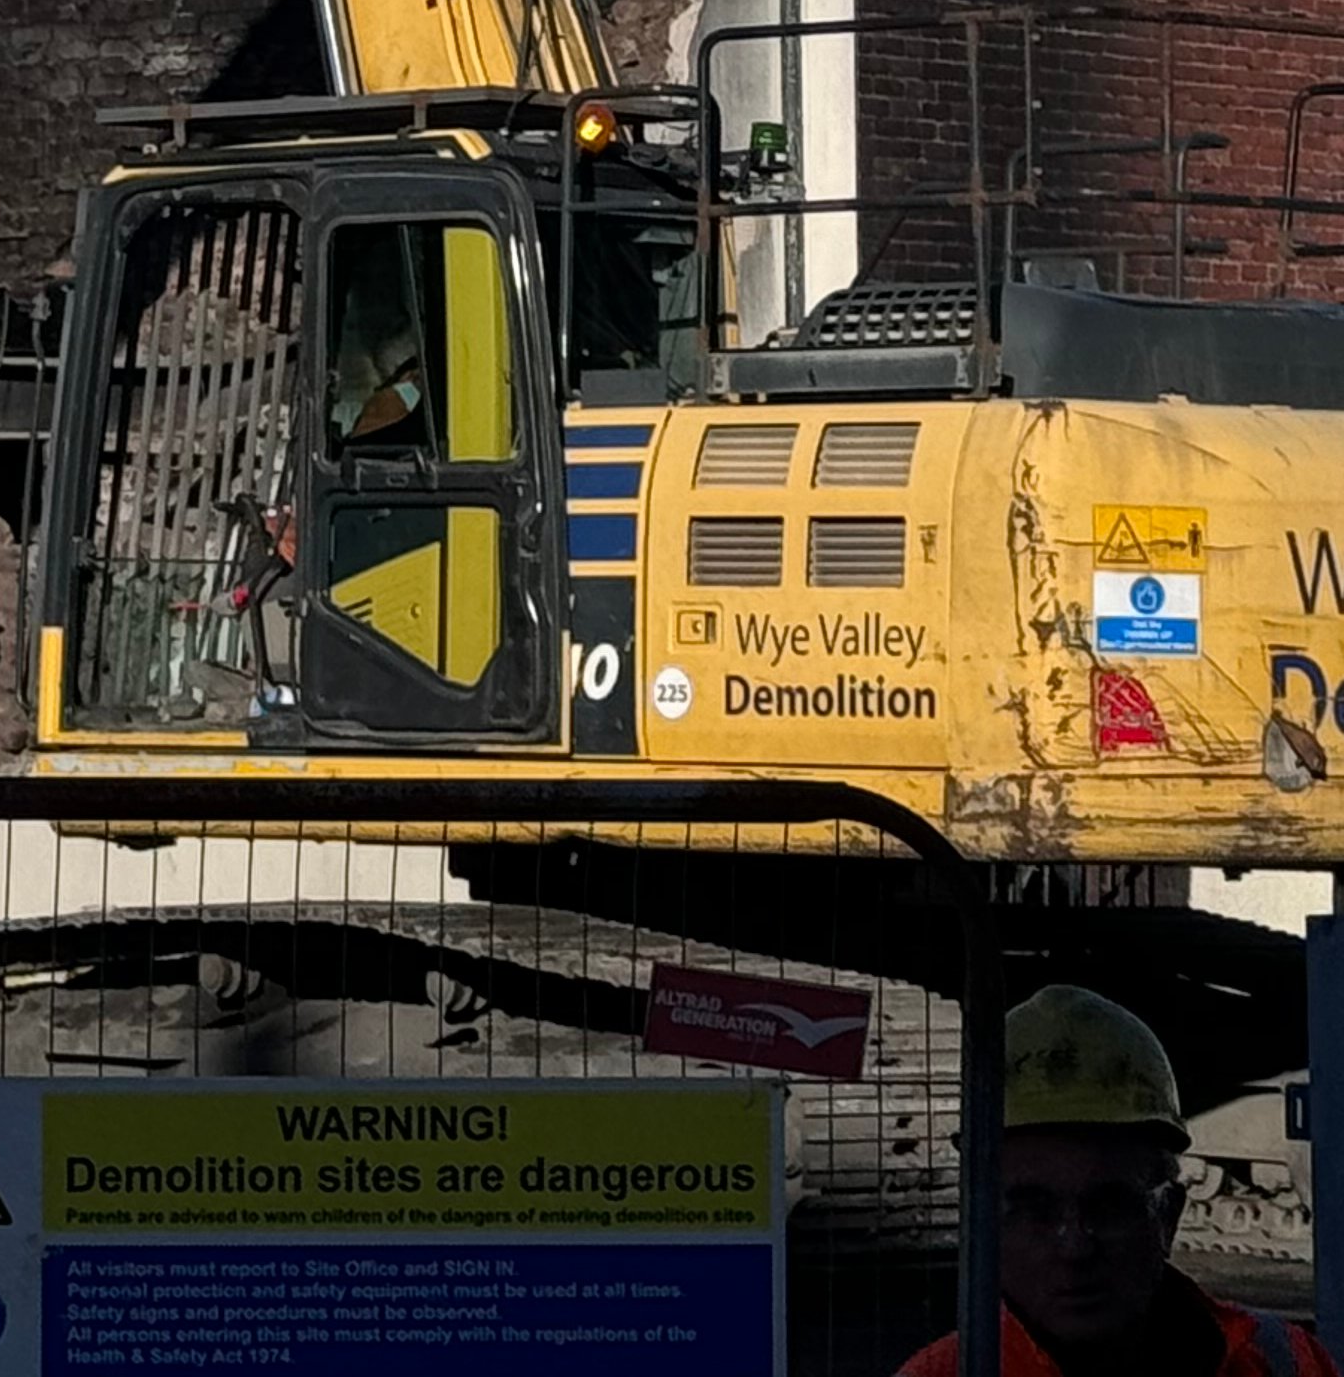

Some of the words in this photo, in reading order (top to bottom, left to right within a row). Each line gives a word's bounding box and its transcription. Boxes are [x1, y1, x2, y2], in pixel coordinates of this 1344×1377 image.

[735, 613, 809, 667] Wye
[818, 612, 926, 667] Valley
[657, 684, 688, 703] 225
[725, 674, 936, 719] Demolition
[655, 989, 724, 1012] ALTRAD
[671, 1007, 778, 1037] GENERATION
[277, 1105, 508, 1142] WARNING!
[66, 1157, 302, 1193] Demolition
[318, 1157, 421, 1193] sites
[436, 1164, 504, 1193] are
[519, 1157, 755, 1201] dangerous
[66, 1209, 132, 1224] Parents
[138, 1212, 163, 1224] are
[170, 1209, 237, 1224] advised
[242, 1209, 259, 1224] to
[311, 1209, 382, 1224] children
[387, 1209, 404, 1224] of
[409, 1209, 437, 1224] the
[442, 1209, 512, 1226] dangers
[517, 1209, 535, 1224] of
[540, 1209, 612, 1226] entering
[616, 1209, 708, 1224] demolition
[713, 1209, 755, 1224] sites
[66, 1260, 92, 1277] All
[96, 1260, 164, 1277] visitors
[170, 1262, 216, 1277] must
[220, 1260, 276, 1280] report
[281, 1261, 300, 1277] to
[304, 1260, 339, 1277] Site
[344, 1260, 399, 1277] Office
[403, 1260, 438, 1277] and
[443, 1260, 491, 1277] SIGN
[495, 1260, 520, 1277] IN.
[67, 1283, 149, 1299] Personal
[153, 1283, 247, 1302] protection
[252, 1283, 286, 1299] and
[291, 1283, 347, 1302] safety
[351, 1283, 449, 1302] equipment
[453, 1283, 500, 1299] must
[504, 1283, 527, 1299] be
[532, 1283, 577, 1299] used
[582, 1283, 601, 1299] at
[604, 1283, 626, 1299] all
[630, 1283, 687, 1299] times.
[66, 1304, 125, 1324] Safety
[130, 1304, 180, 1324] signs
[185, 1304, 219, 1321] and
[223, 1304, 328, 1324] procedures
[333, 1304, 380, 1321] must
[384, 1304, 407, 1321] be
[412, 1304, 503, 1321] observed.
[66, 1326, 92, 1343] All
[96, 1326, 171, 1346] persons
[176, 1326, 252, 1346] entering
[256, 1326, 291, 1343] this
[296, 1326, 330, 1343] site
[334, 1326, 381, 1343] must
[385, 1326, 453, 1346] comply
[458, 1326, 496, 1343] with
[501, 1326, 531, 1343] the
[535, 1326, 640, 1346] regulations
[644, 1326, 663, 1343] of
[668, 1326, 697, 1343] the
[67, 1348, 126, 1365] Health
[130, 1348, 145, 1365] &
[149, 1348, 207, 1368] Safety
[211, 1348, 243, 1365] Act
